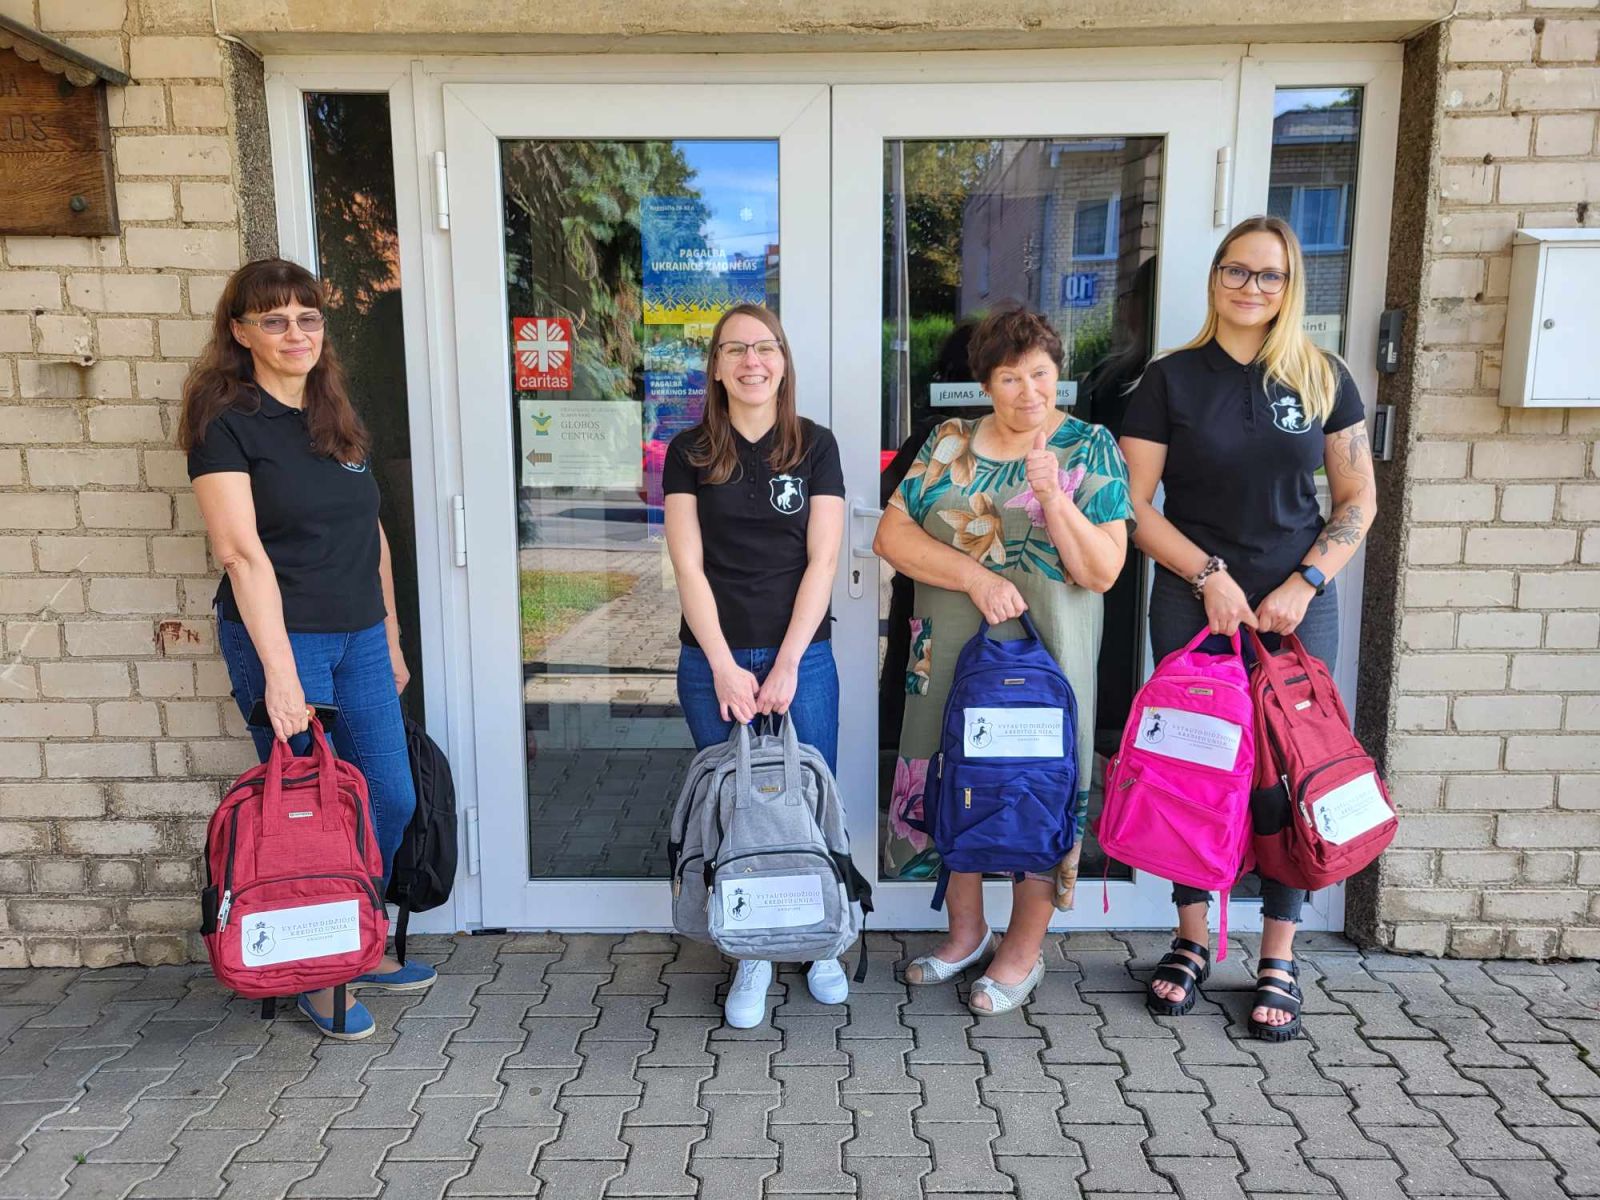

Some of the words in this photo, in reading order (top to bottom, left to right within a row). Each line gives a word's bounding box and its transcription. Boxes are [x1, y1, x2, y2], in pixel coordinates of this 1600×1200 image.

[679, 249, 726, 258] PAGALBA
[651, 261, 704, 271] UKRAINOS
[520, 373, 569, 388] caritas
[650, 380, 683, 388] PAGALBA
[688, 388, 706, 396] ŽMO
[560, 420, 600, 430] GLOBOS
[561, 431, 606, 441] CENTRAS
